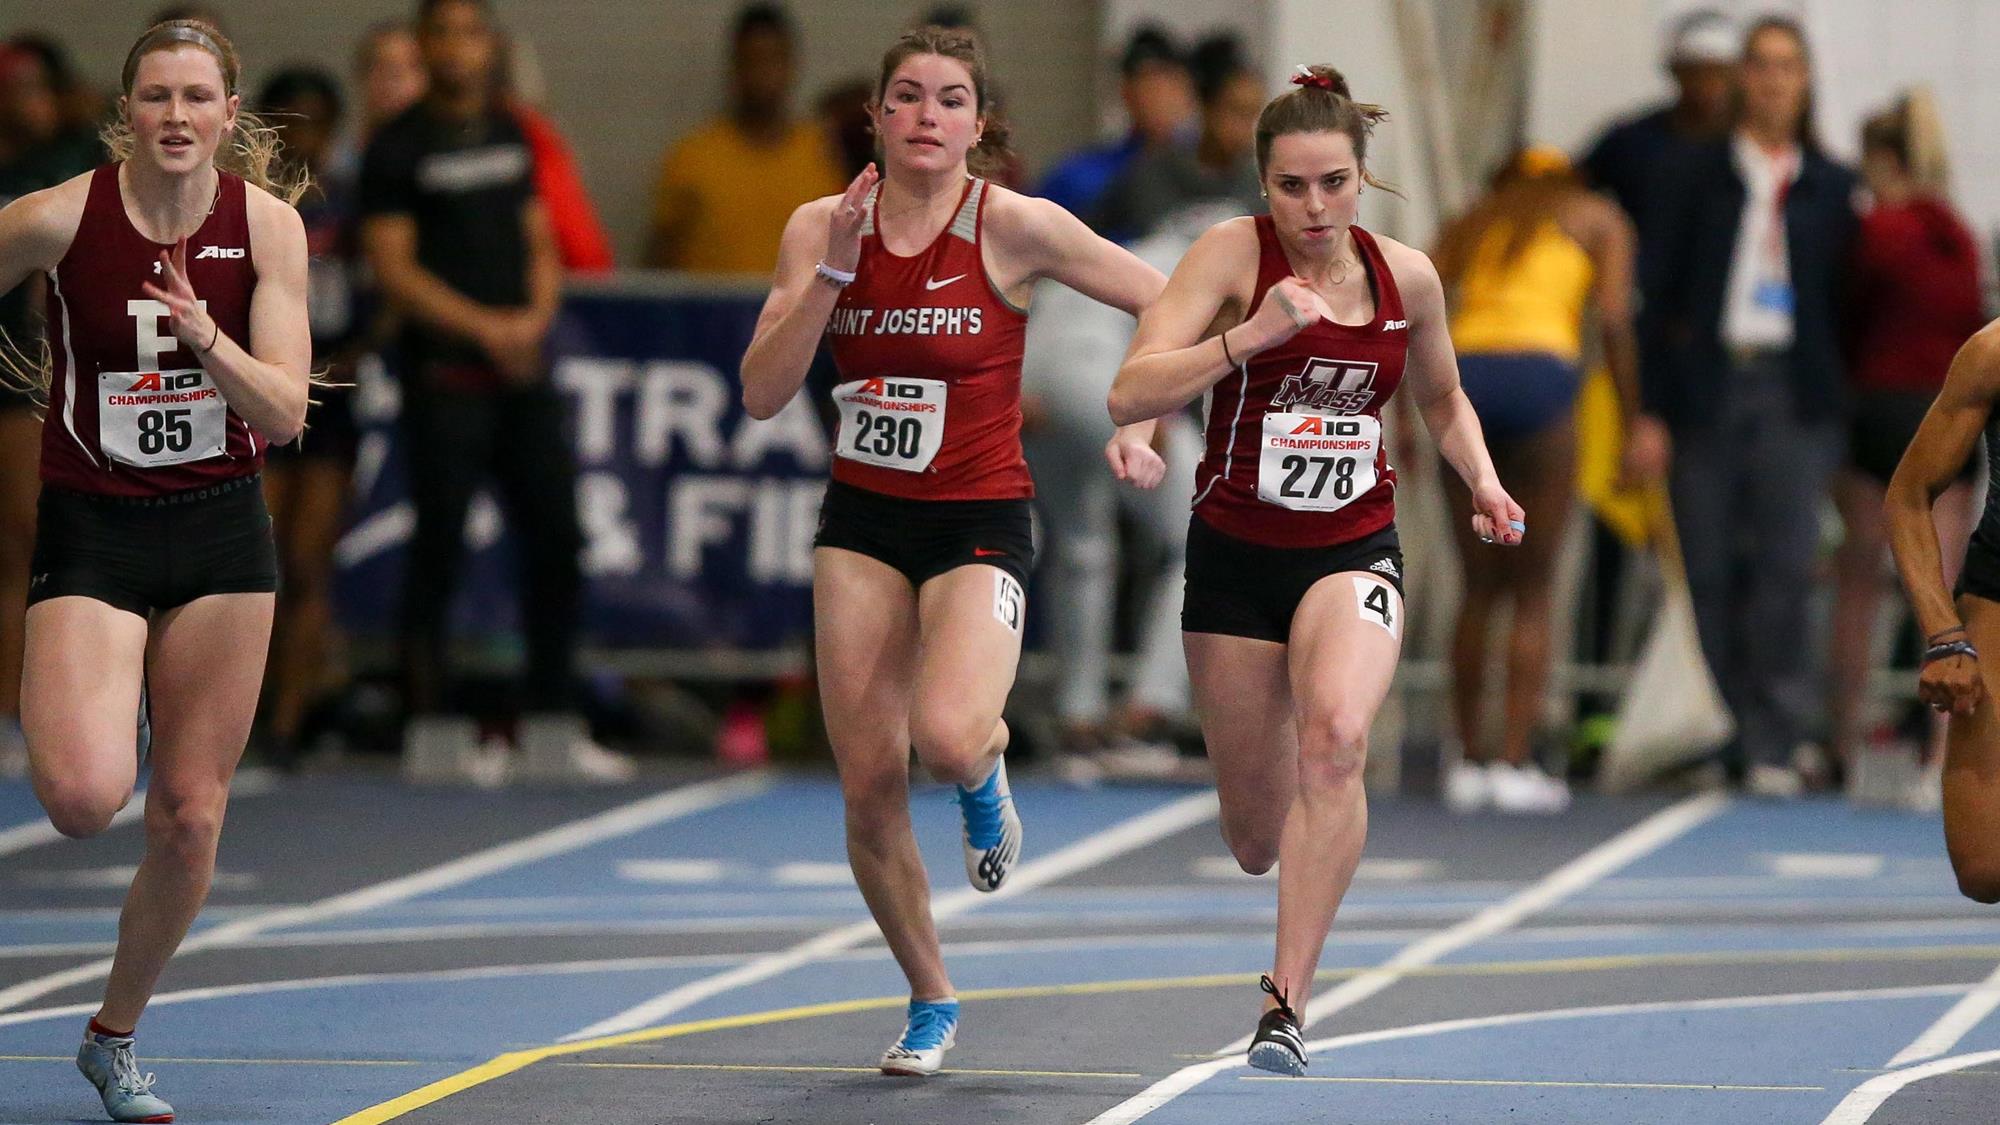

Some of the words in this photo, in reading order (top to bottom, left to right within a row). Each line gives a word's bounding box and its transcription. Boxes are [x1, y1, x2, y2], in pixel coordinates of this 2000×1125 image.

[195, 246, 245, 259] A10
[826, 308, 873, 335] AINT
[874, 307, 982, 335] JOSEPH'S
[1382, 320, 1407, 331] A10
[126, 372, 202, 392] A10
[856, 377, 924, 399] A10
[108, 388, 217, 405] CHAMPIONSHIPS
[841, 395, 937, 413] CHAMPIONSHIPS
[138, 408, 192, 455] 85
[854, 410, 922, 459] 230
[1288, 416, 1360, 436] A10
[1270, 438, 1371, 450] CHAMPIONSHIPS
[1280, 455, 1357, 500] 278
[1364, 585, 1393, 628] 4
